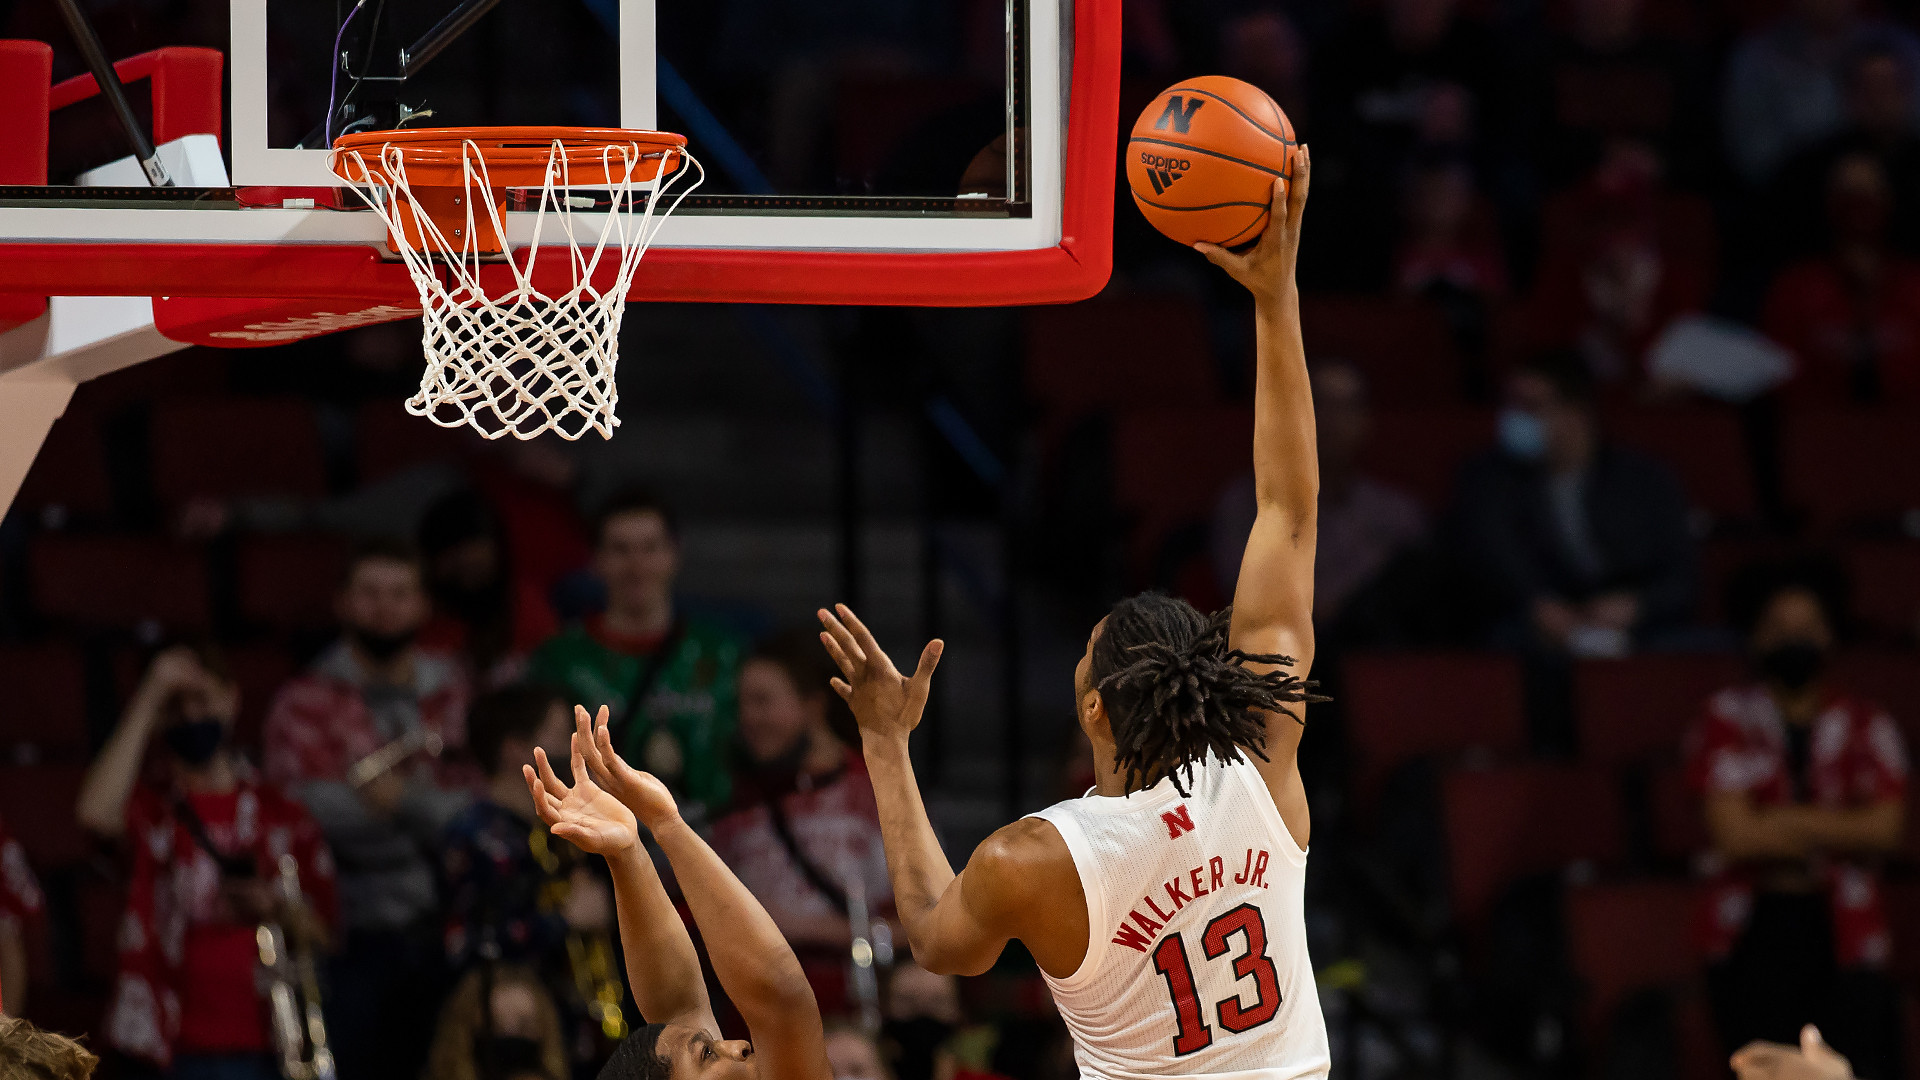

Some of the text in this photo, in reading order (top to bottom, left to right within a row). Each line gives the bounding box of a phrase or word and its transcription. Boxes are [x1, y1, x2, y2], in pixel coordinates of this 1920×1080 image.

[1154, 95, 1205, 134] N
[1140, 151, 1191, 173] adidas
[1160, 803, 1195, 840] N
[1111, 848, 1270, 953] WALKER JR.
[1151, 902, 1283, 1057] 13
